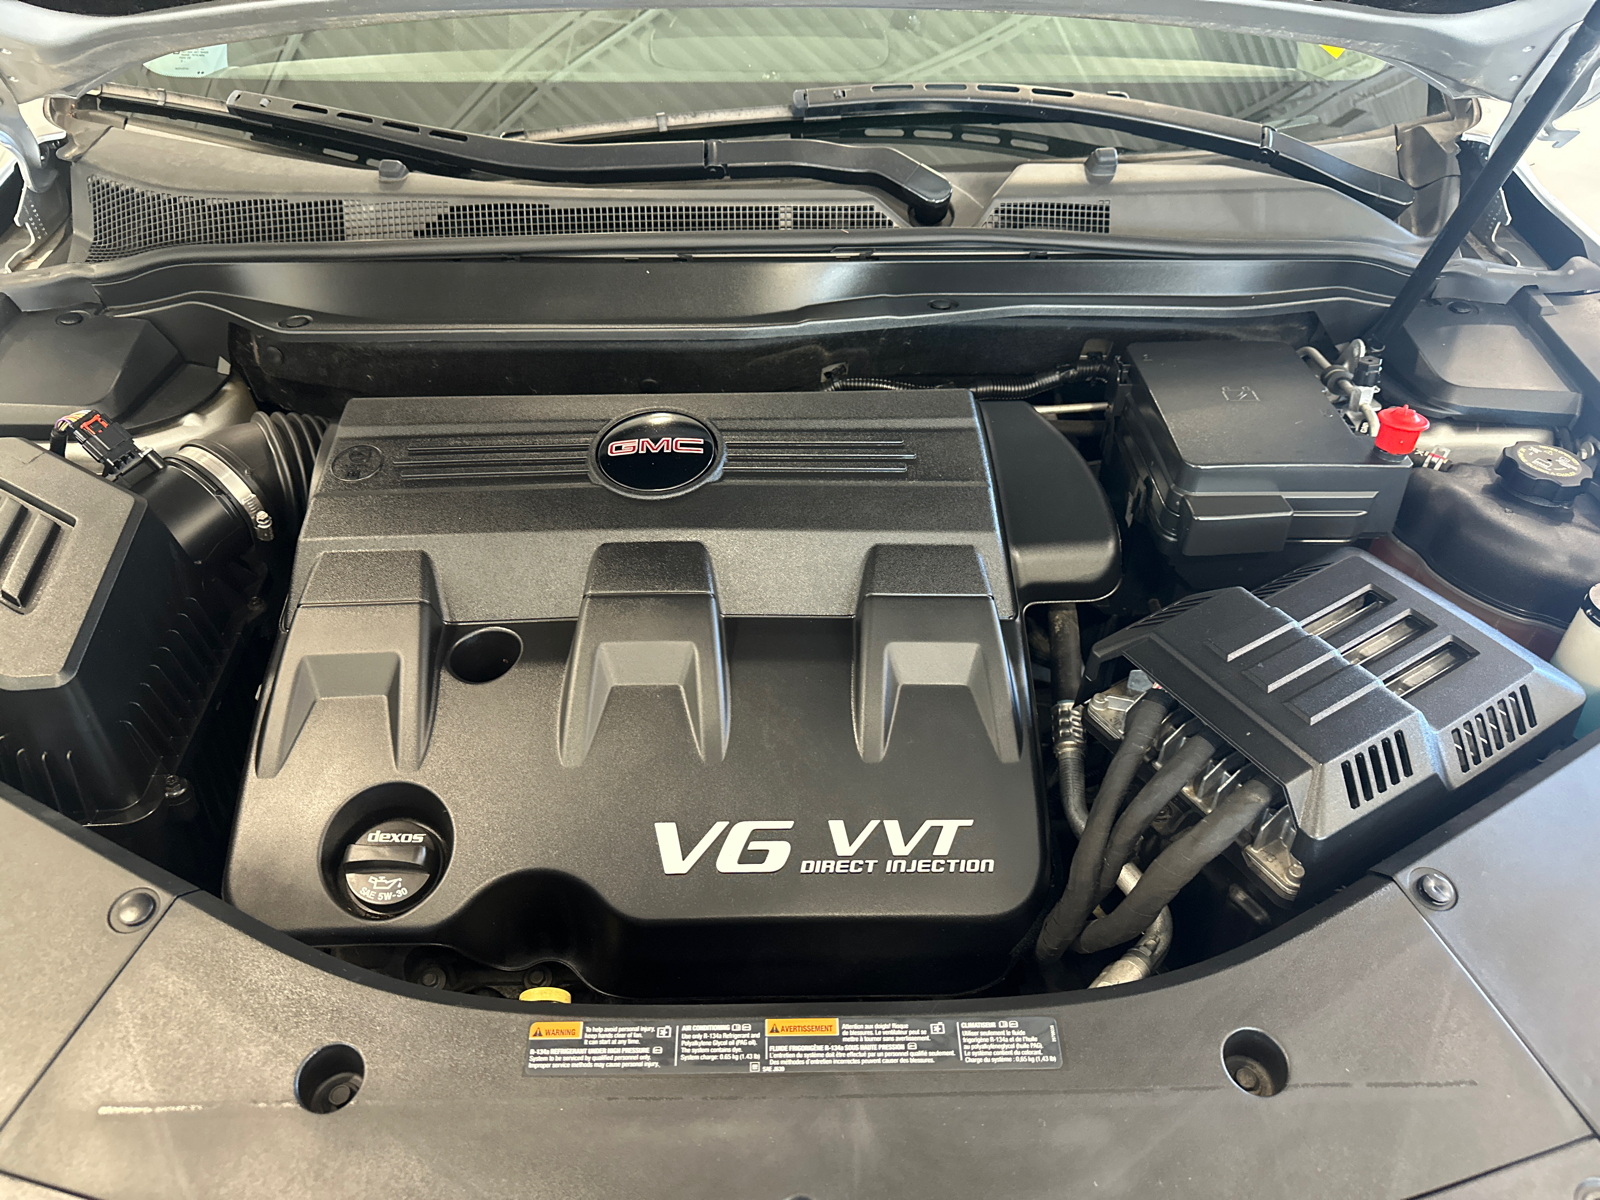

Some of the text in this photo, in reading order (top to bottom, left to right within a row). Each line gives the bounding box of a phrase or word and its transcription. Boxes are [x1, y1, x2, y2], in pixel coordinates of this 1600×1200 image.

[608, 437, 704, 457] GMC
[367, 830, 427, 843] dexos
[827, 819, 975, 857] VVT
[654, 820, 795, 875] V6
[800, 859, 995, 874] DIRECT INJECTION
[359, 886, 409, 901] SAE 5W-30
